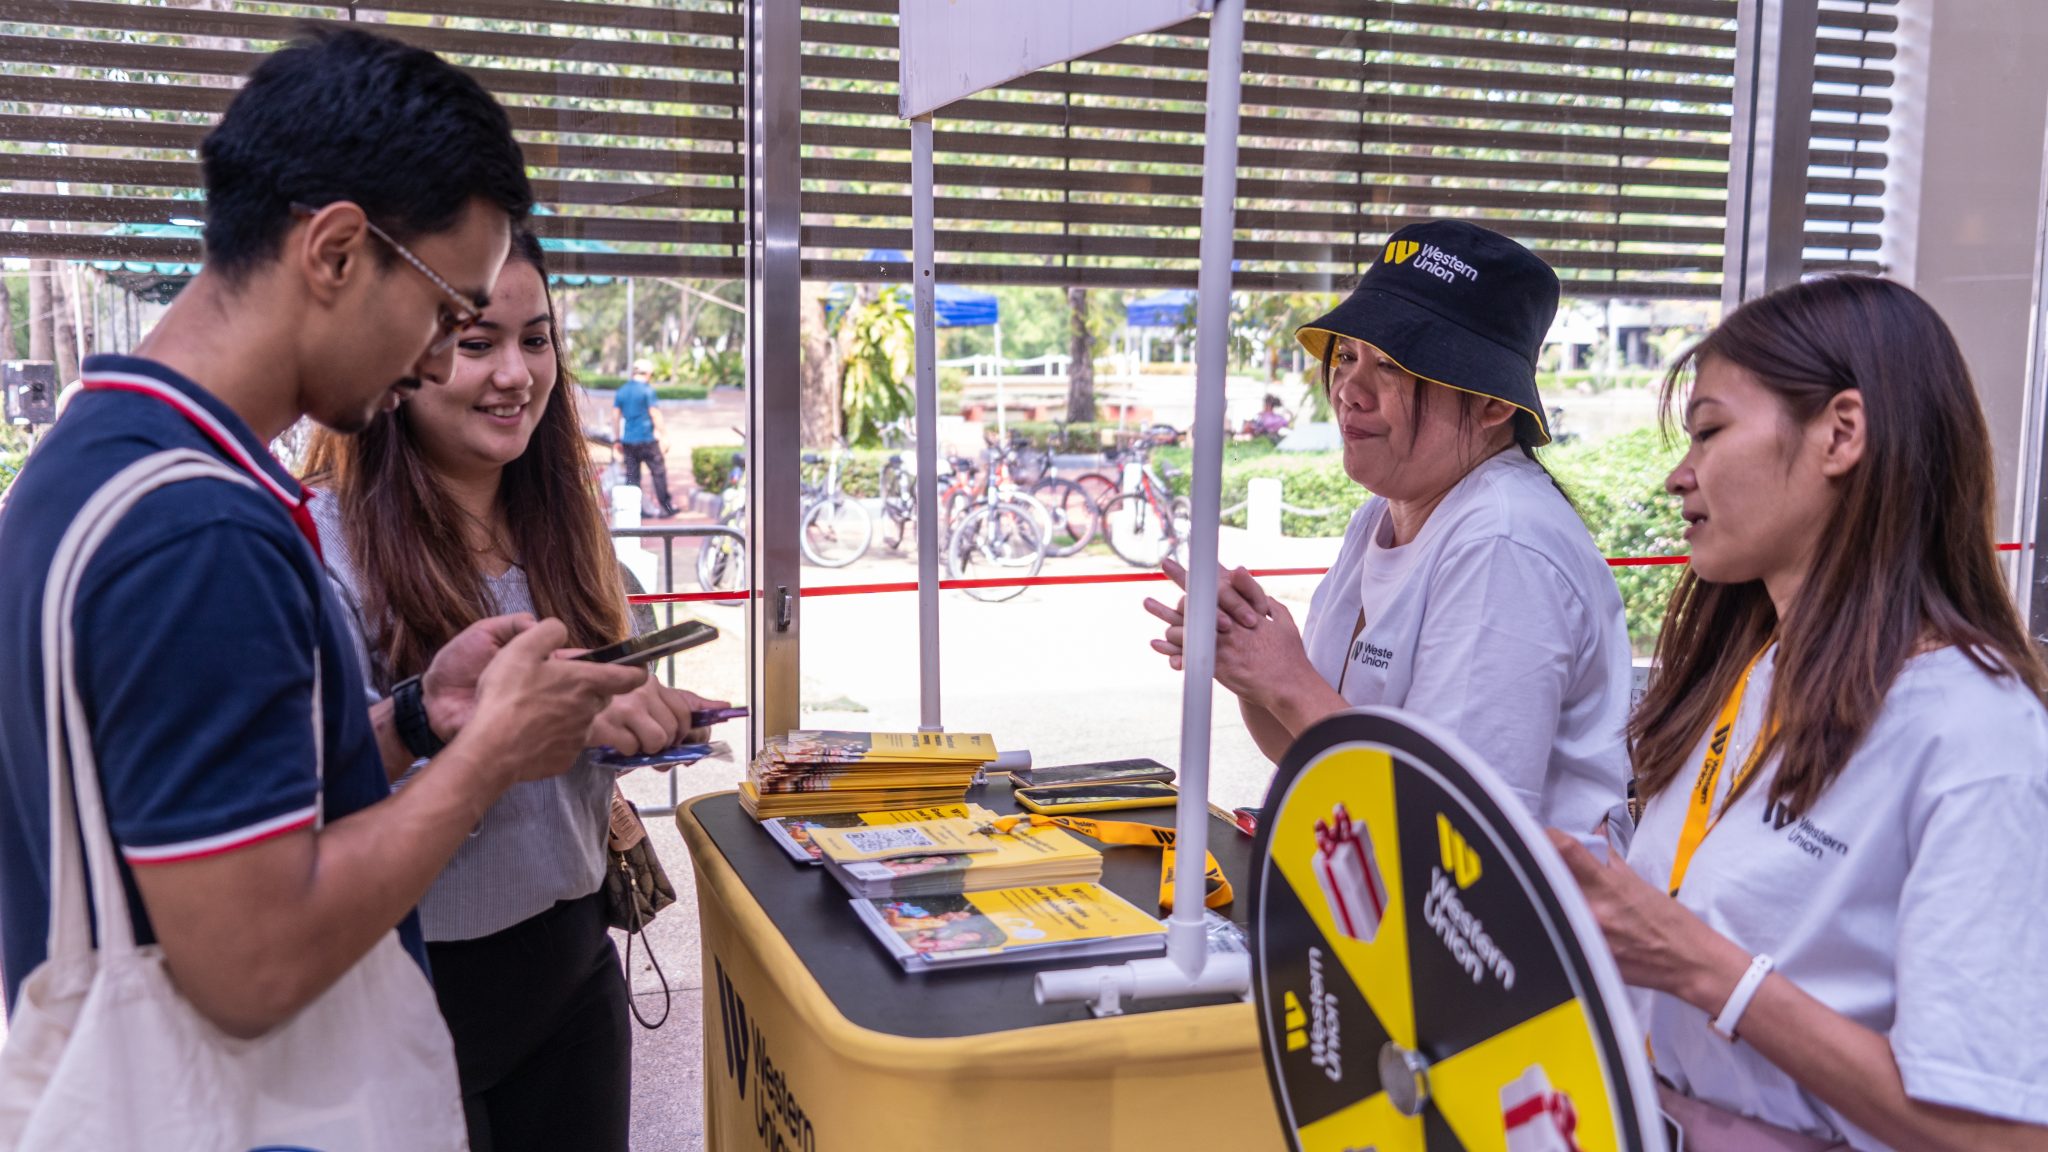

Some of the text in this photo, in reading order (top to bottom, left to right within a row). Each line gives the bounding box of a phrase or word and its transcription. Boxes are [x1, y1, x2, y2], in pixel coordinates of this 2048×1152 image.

[1412, 255, 1455, 283] Union
[1421, 243, 1478, 281] Western
[1361, 653, 1388, 669] Union
[1364, 642, 1393, 659] Weste
[1787, 827, 1823, 859] Union
[1798, 816, 1848, 854] Western
[1423, 890, 1484, 985] Union
[1431, 865, 1516, 992] Western
[1308, 946, 1326, 1067] Western
[1324, 992, 1343, 1083] Union
[751, 1016, 815, 1152] Western
